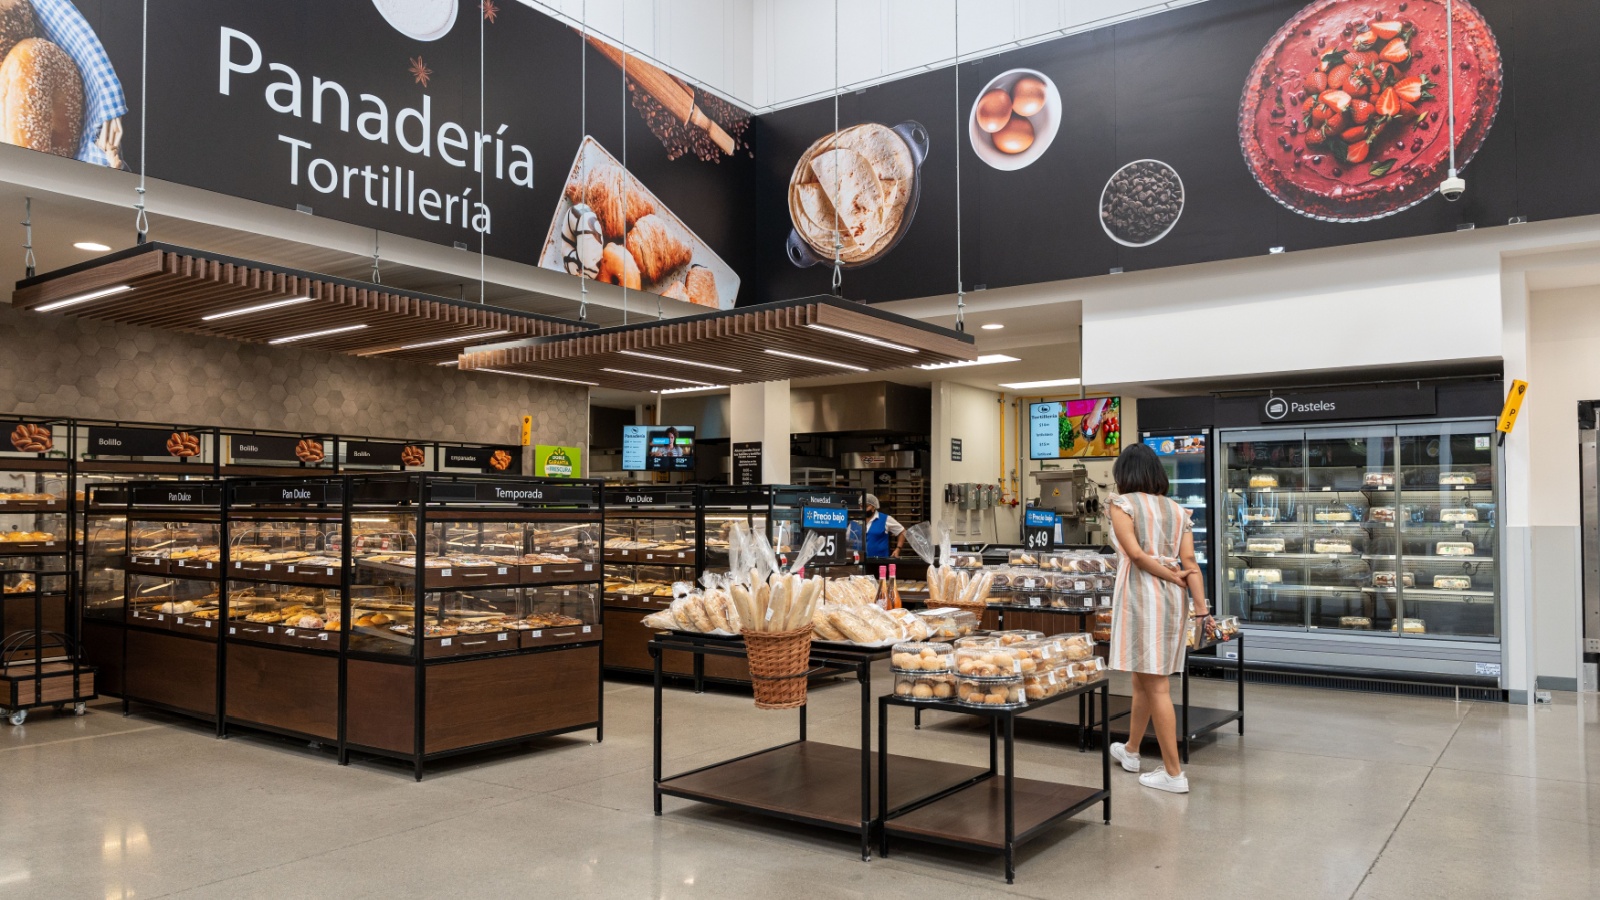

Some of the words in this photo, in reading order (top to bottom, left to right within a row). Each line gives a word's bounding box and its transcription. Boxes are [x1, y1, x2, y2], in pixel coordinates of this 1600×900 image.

[219, 26, 534, 189] Panadería
[278, 134, 491, 234] Tortillería
[1291, 400, 1336, 413] Pasteles
[1504, 421, 1511, 430] 3
[98, 437, 122, 447] Bolillo
[239, 444, 259, 452] Bolillo
[168, 492, 177, 501] Pan
[177, 492, 192, 502] Dulce
[282, 489, 293, 499] Pan
[293, 489, 311, 499] Dulce
[495, 487, 543, 500] Temporada
[625, 495, 636, 503] Pan
[637, 495, 653, 503] Dulce
[810, 495, 831, 504] Novedad
[813, 511, 831, 521] Precio
[832, 511, 845, 523] bajo
[1032, 513, 1045, 521] Precio
